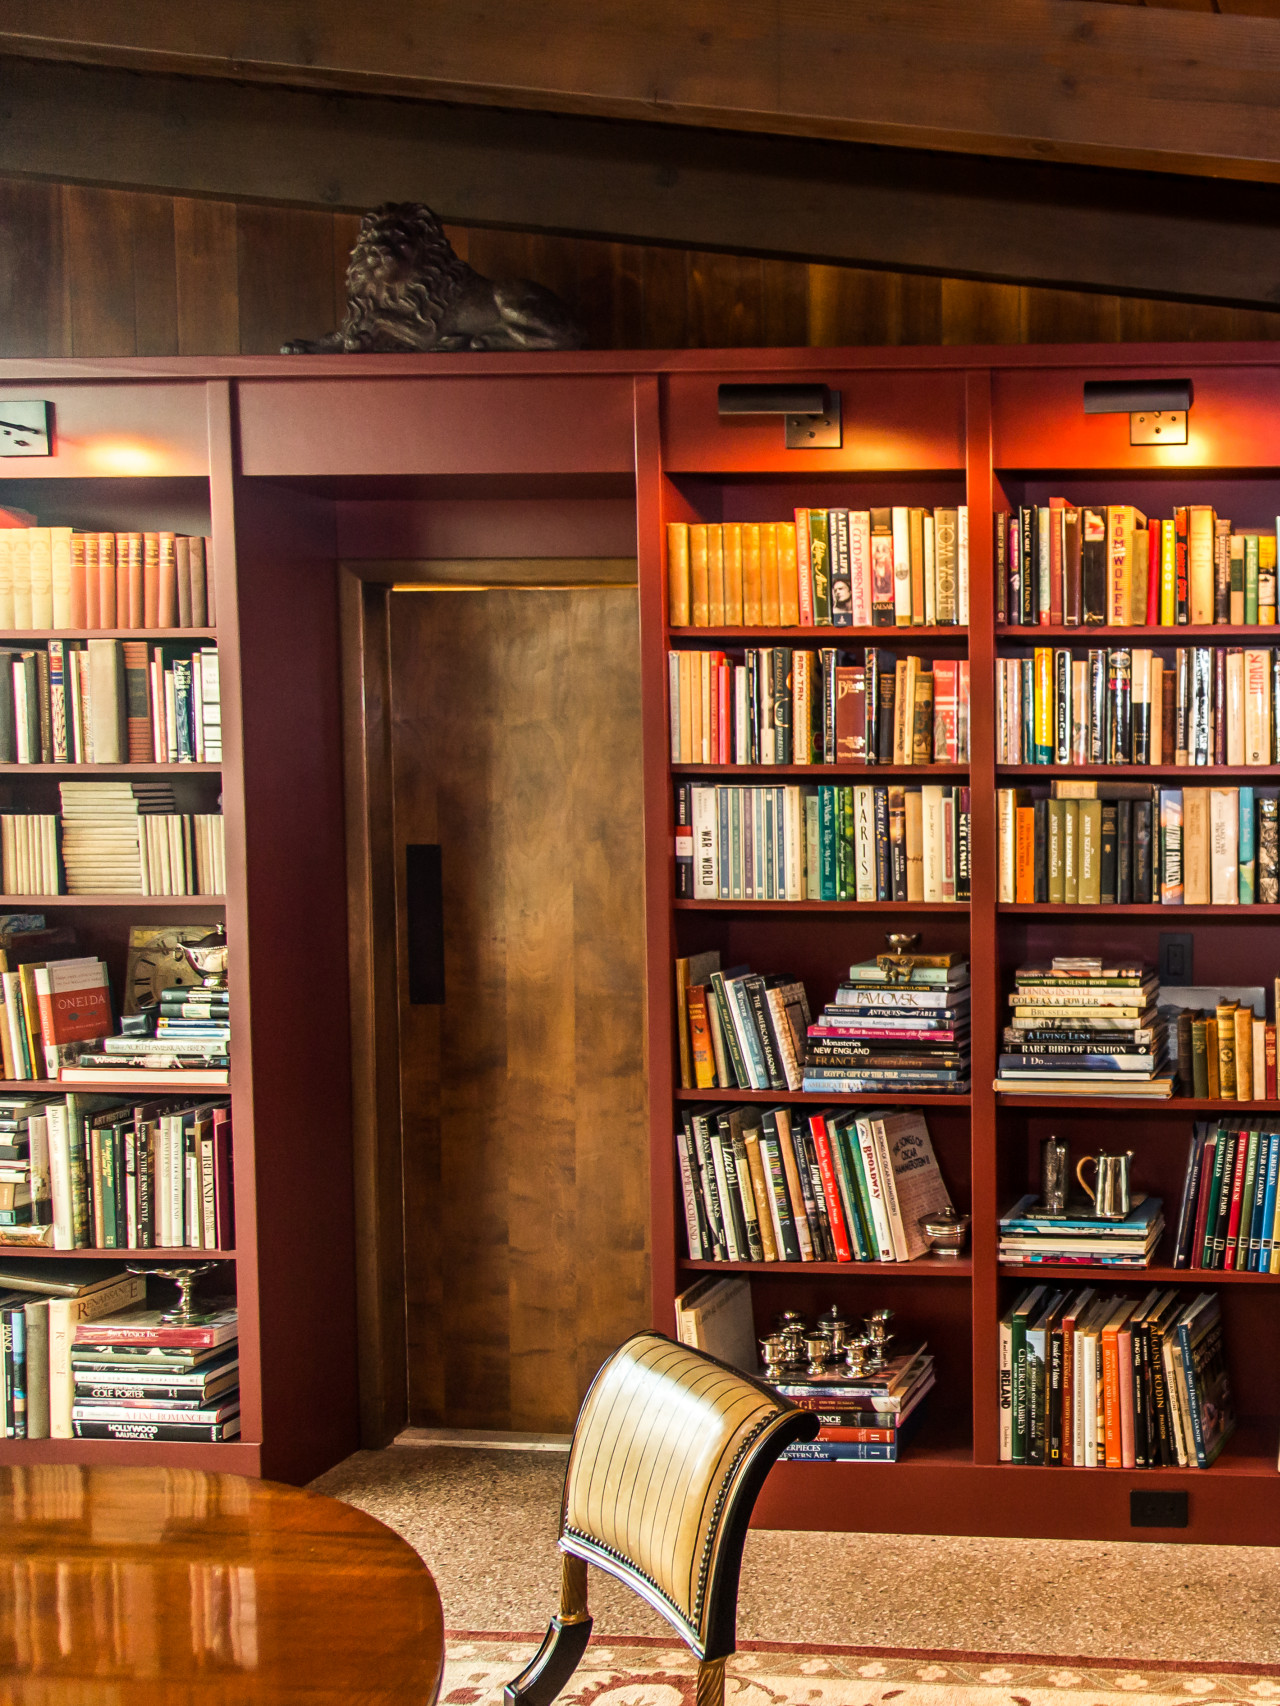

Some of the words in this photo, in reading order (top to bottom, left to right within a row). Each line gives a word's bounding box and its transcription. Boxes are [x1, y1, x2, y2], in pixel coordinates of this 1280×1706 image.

[839, 521, 848, 552] LITTLE
[853, 528, 862, 555] GOOD
[938, 522, 955, 558] TOM
[1114, 514, 1126, 551] TOM
[840, 554, 848, 574] LIFE
[854, 557, 864, 608] APPRENTICE
[938, 564, 955, 612] WOLFE
[1114, 557, 1126, 617] WOLFE
[1248, 654, 1264, 695] SCARLETT
[860, 791, 868, 875] PARIS
[959, 814, 968, 838] NOËL
[1000, 813, 1008, 834] Help
[1084, 815, 1092, 835] JOHN
[702, 831, 713, 847] WAR
[702, 857, 713, 886] WORLD
[959, 840, 968, 879] COWARD
[1084, 836, 1092, 879] STEINBECK
[1167, 851, 1181, 887] FRANZEN
[58, 995, 106, 1010] ONEIDA
[737, 990, 746, 1017] WINTER
[857, 992, 919, 1005] PAVLOVSK
[41, 1011, 49, 1039] ONEIDA
[753, 995, 761, 1008] THE
[757, 1010, 769, 1045] AMERICAN
[764, 1046, 776, 1075] SEASONS
[700, 1124, 711, 1153] TIFFANY
[1250, 1137, 1258, 1159] HAGIA
[1260, 1139, 1268, 1165] TOWER
[706, 1160, 715, 1179] TABLE
[722, 1147, 734, 1172] Lace
[767, 1141, 782, 1183] BROADWAY
[1215, 1137, 1226, 1177] VERSAILLES
[1223, 1140, 1235, 1184] NOTRE-DAME
[1236, 1154, 1244, 1178] WHITE
[1259, 1166, 1266, 1175] OF
[1269, 1154, 1277, 1185] KREMLIN
[203, 1156, 214, 1203] IRELAND
[863, 1145, 881, 1199] BROADWAY
[1247, 1160, 1255, 1185] SOPHIA
[709, 1183, 721, 1218] SETTINGS
[1223, 1186, 1229, 1195] DE
[1233, 1179, 1241, 1202] HOUSE
[1257, 1177, 1265, 1206] LONDON
[686, 1198, 698, 1240] SCOTLAND
[774, 1186, 790, 1226] MUSICALS
[1220, 1197, 1228, 1216] PARIS
[4, 1324, 13, 1352] PIANO
[1052, 1341, 1060, 1358] Inside
[1150, 1325, 1161, 1370] AUGUSTE
[1018, 1349, 1026, 1400] CISTERCIAN
[1052, 1358, 1060, 1368] the
[91, 1389, 114, 1398] COLE
[115, 1389, 145, 1398] PORTER
[1001, 1370, 1011, 1409] IRELAND
[1155, 1375, 1164, 1408] RODIN
[108, 1425, 159, 1433] HOLLYWOOD
[158, 1413, 203, 1422] ROMANCE
[1018, 1403, 1026, 1434] ABBEYS
